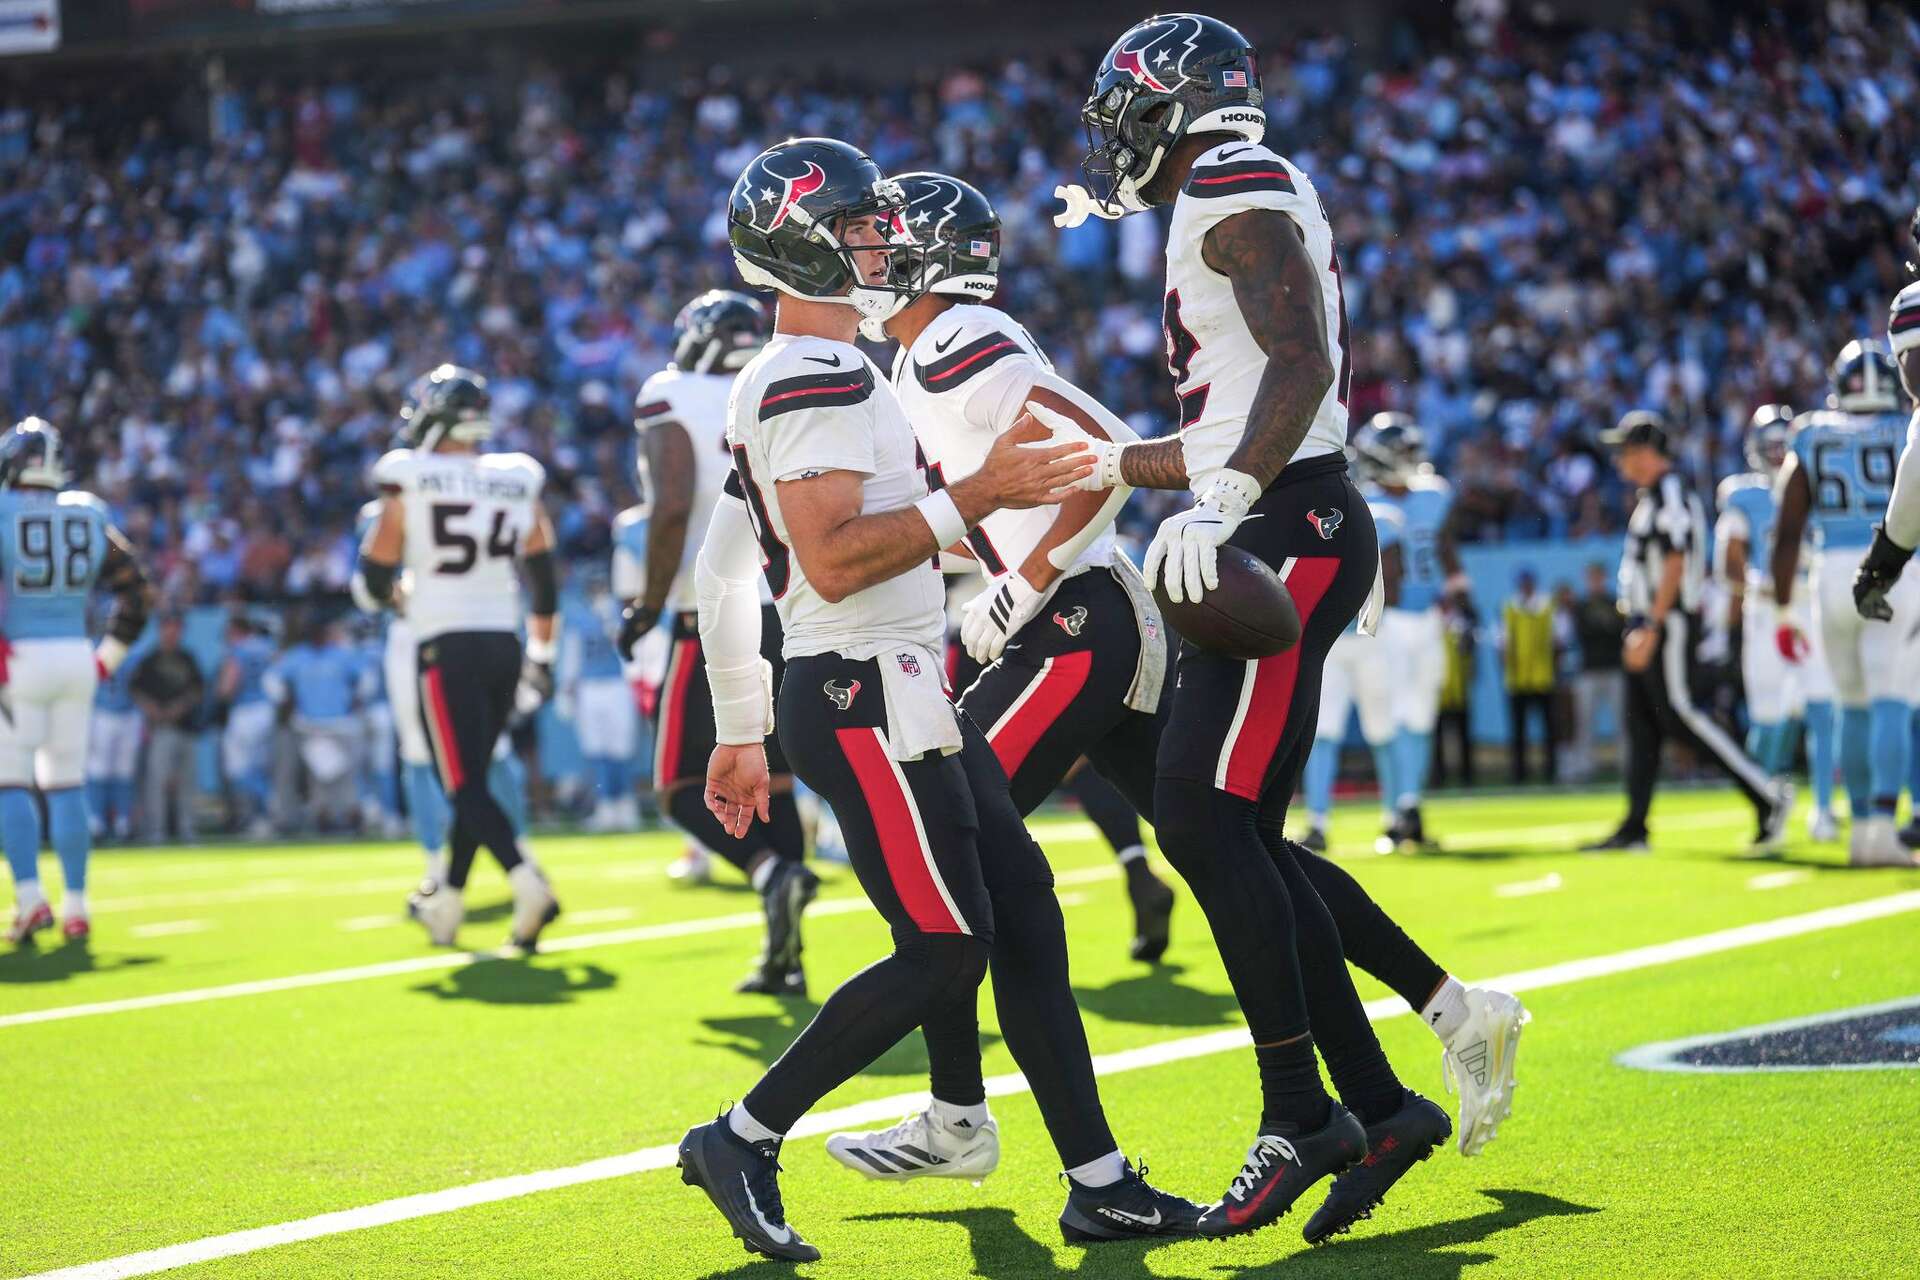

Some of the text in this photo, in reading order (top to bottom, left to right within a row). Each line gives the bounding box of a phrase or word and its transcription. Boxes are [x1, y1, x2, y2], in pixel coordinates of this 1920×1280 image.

[1810, 438, 1897, 516] 69
[16, 514, 92, 595] 98
[431, 503, 519, 575] 54
